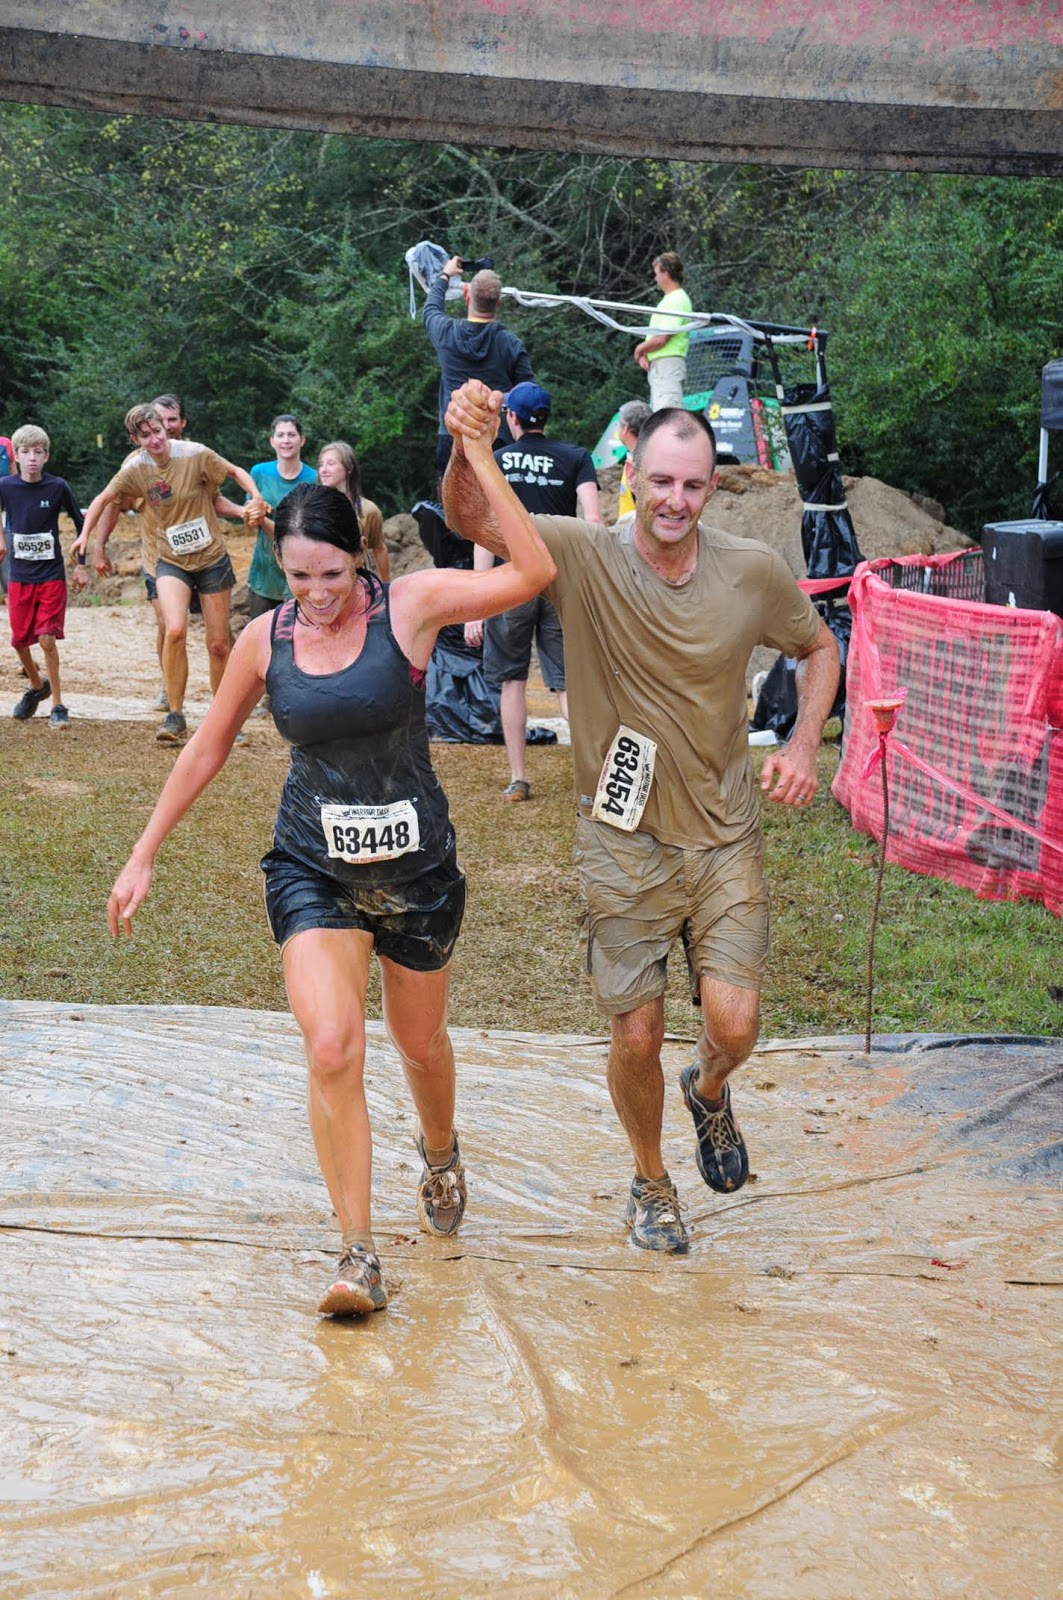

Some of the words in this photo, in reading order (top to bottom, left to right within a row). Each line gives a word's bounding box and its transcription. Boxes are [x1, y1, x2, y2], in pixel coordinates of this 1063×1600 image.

[502, 452, 554, 473] STAFF
[172, 527, 205, 546] 65531
[601, 736, 640, 816] 63454
[332, 821, 410, 854] 63448
